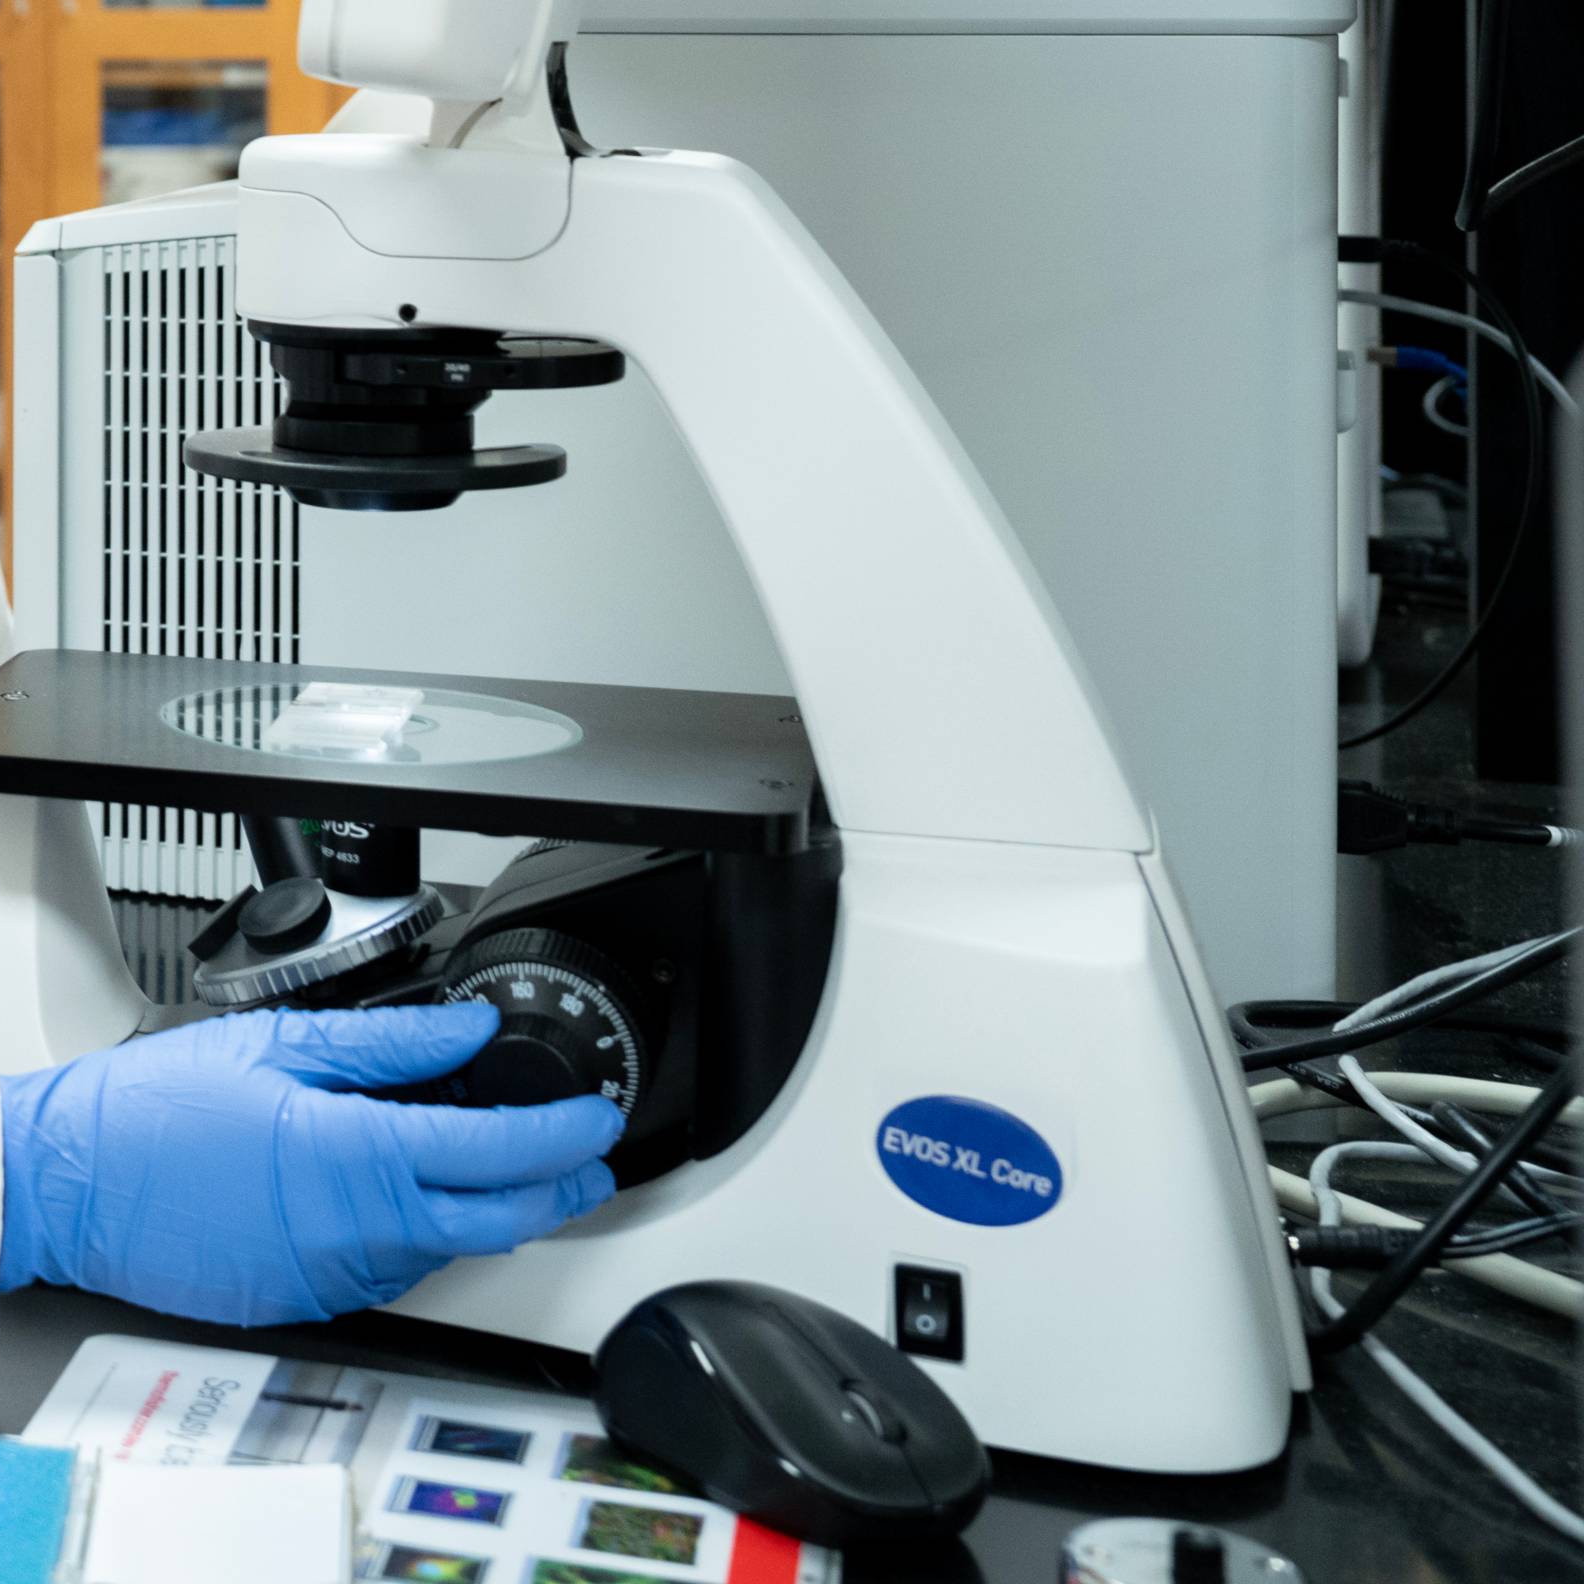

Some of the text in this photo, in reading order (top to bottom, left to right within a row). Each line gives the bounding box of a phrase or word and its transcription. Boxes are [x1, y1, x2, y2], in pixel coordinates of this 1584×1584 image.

[320, 818, 370, 839] VOS
[509, 980, 536, 1000] 160
[558, 992, 585, 1017] 180
[600, 1079, 621, 1100] 20
[882, 1125, 1054, 1198] EVOS XL Core
